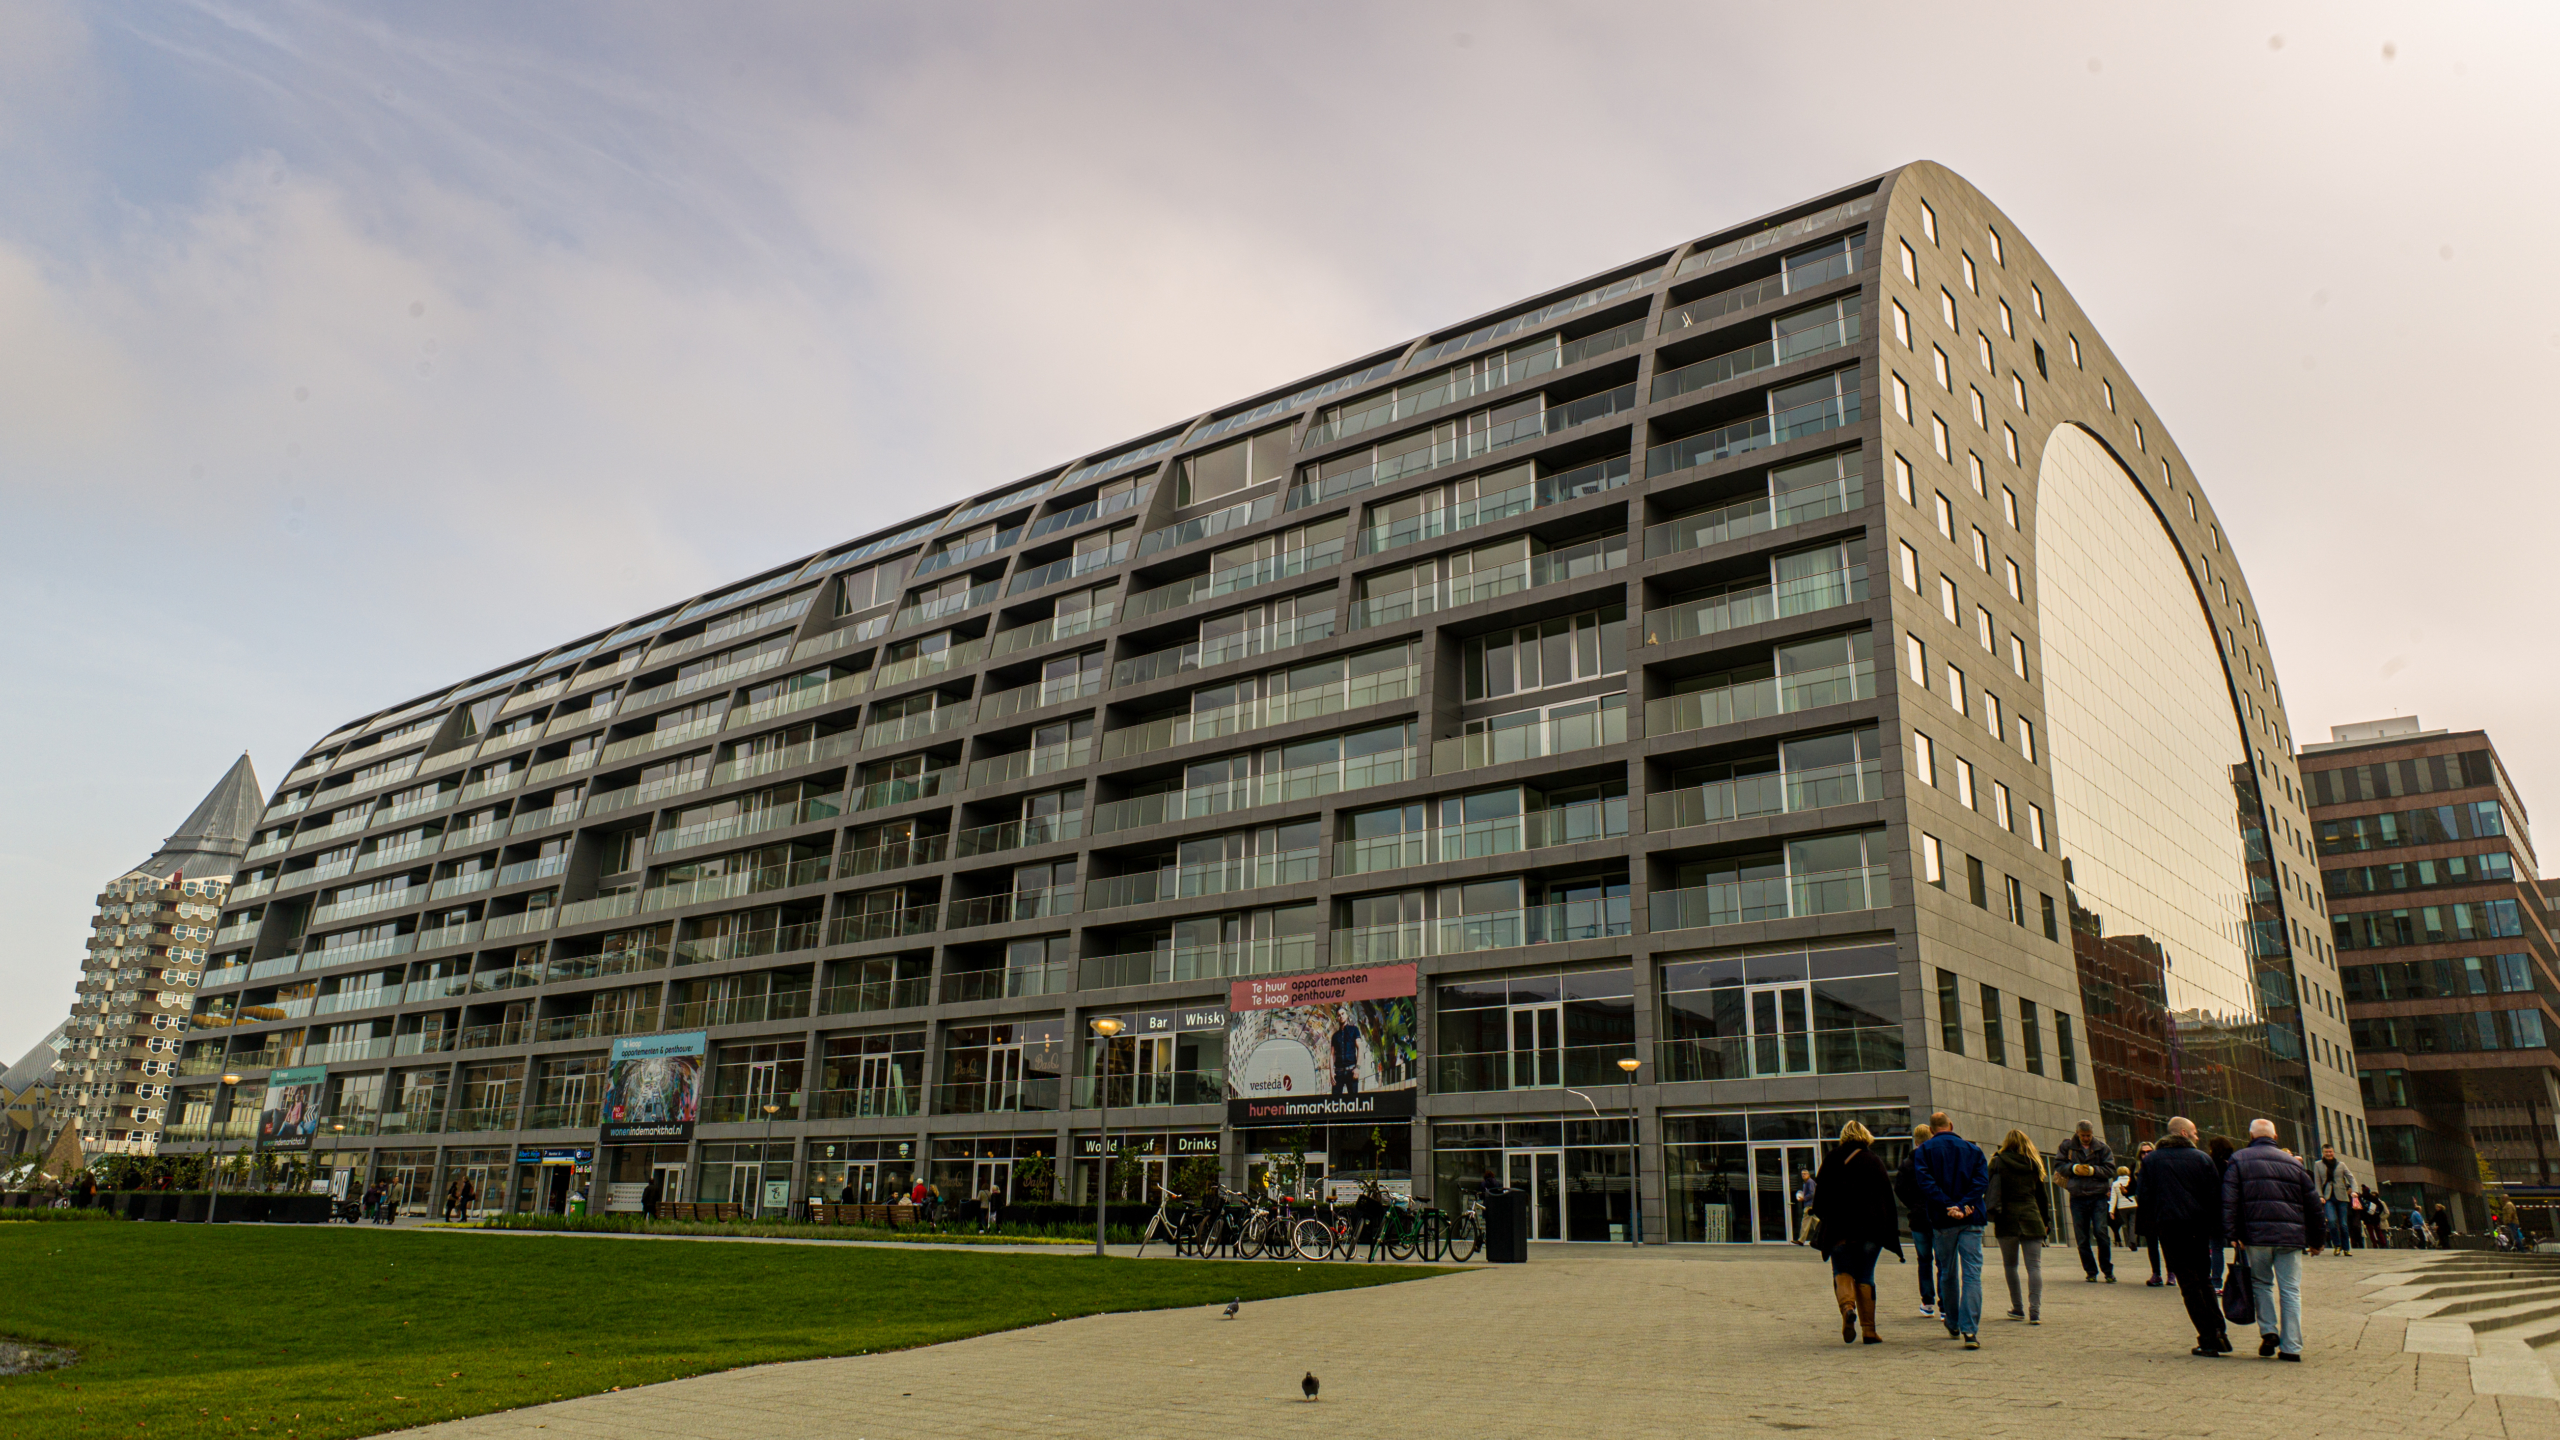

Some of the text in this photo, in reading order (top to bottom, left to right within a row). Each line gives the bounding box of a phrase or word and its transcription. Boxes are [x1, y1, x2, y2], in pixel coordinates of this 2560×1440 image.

[1252, 974, 1368, 994] Te huur appartementen
[1252, 989, 1346, 1006] Te koop penthouses
[1149, 1017, 1168, 1029] Bar
[621, 1047, 659, 1058] appartementen
[1249, 1079, 1282, 1091] vesteda
[1249, 1096, 1374, 1117] hureninmarkthal.nl
[610, 1124, 683, 1137] wonenindemarkthal.nl
[1085, 1139, 1118, 1153] Wold
[1178, 1137, 1218, 1151] Drinks
